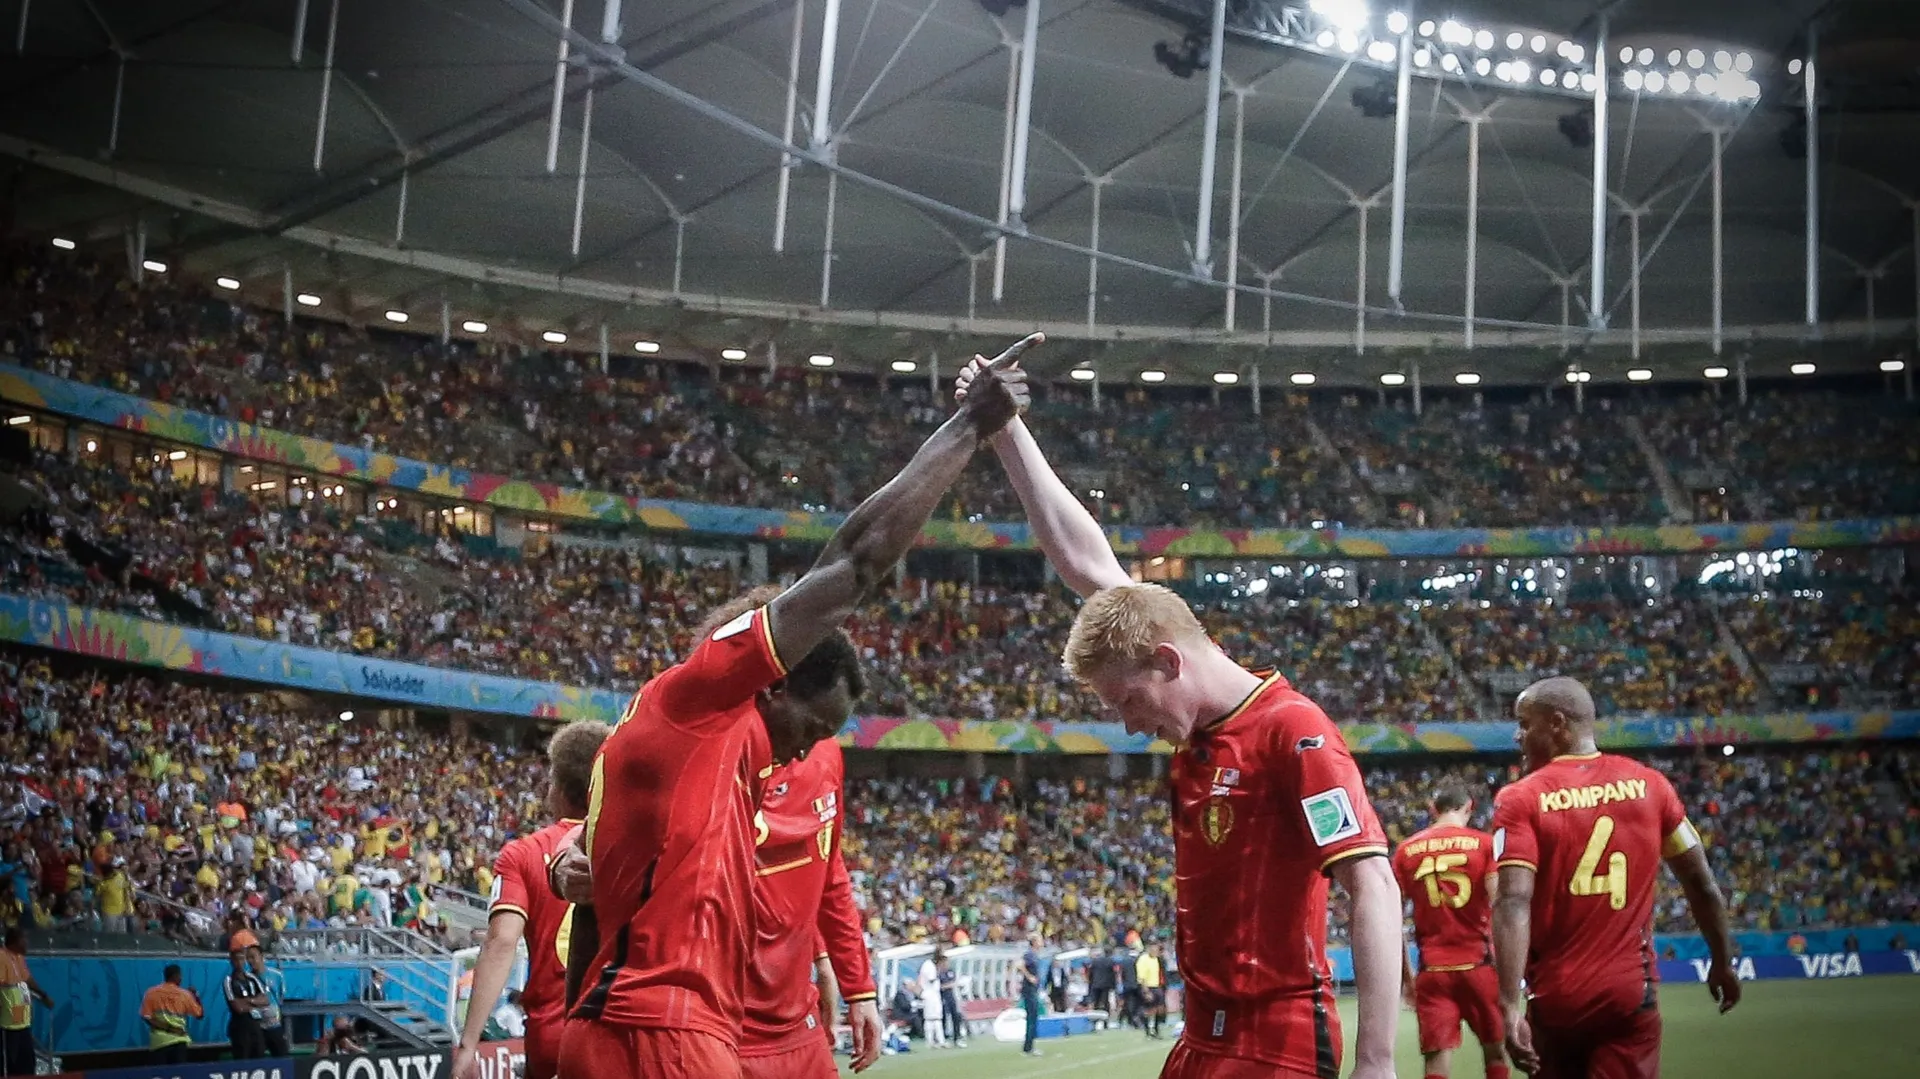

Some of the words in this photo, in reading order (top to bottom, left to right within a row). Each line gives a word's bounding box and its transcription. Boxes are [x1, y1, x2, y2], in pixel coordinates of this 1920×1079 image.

[362, 665, 424, 695] Salvador
[1540, 779, 1646, 813] KOMPANY
[1427, 836, 1480, 852] BUYTEN
[1569, 815, 1628, 911] 4
[1413, 855, 1472, 909] 15
[1797, 952, 1864, 978] VISA
